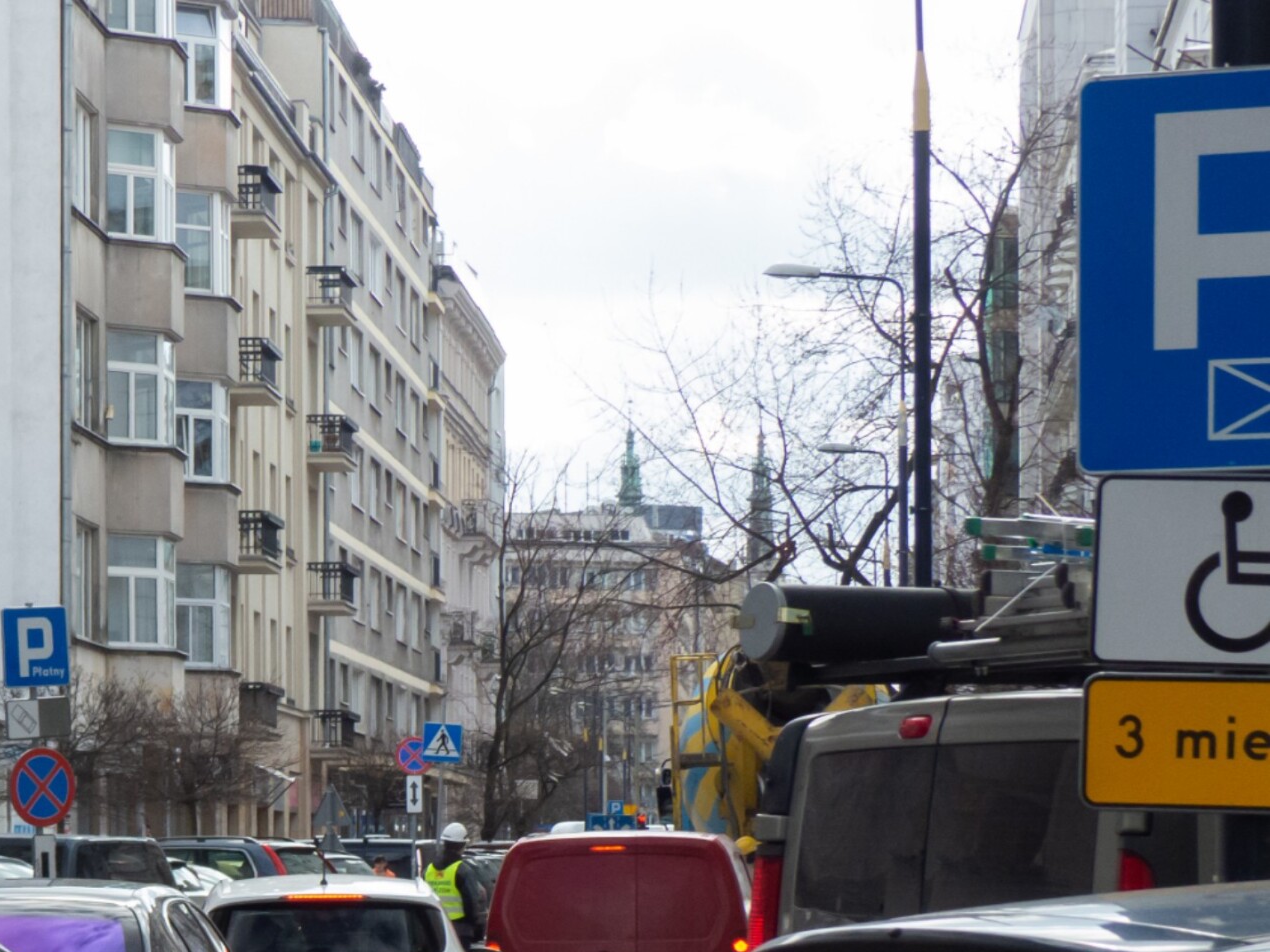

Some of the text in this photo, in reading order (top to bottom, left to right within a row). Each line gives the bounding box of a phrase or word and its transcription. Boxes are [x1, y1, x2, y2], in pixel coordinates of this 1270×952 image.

[17, 616, 54, 678] P
[1114, 714, 1145, 759] 3
[611, 802, 621, 814] P
